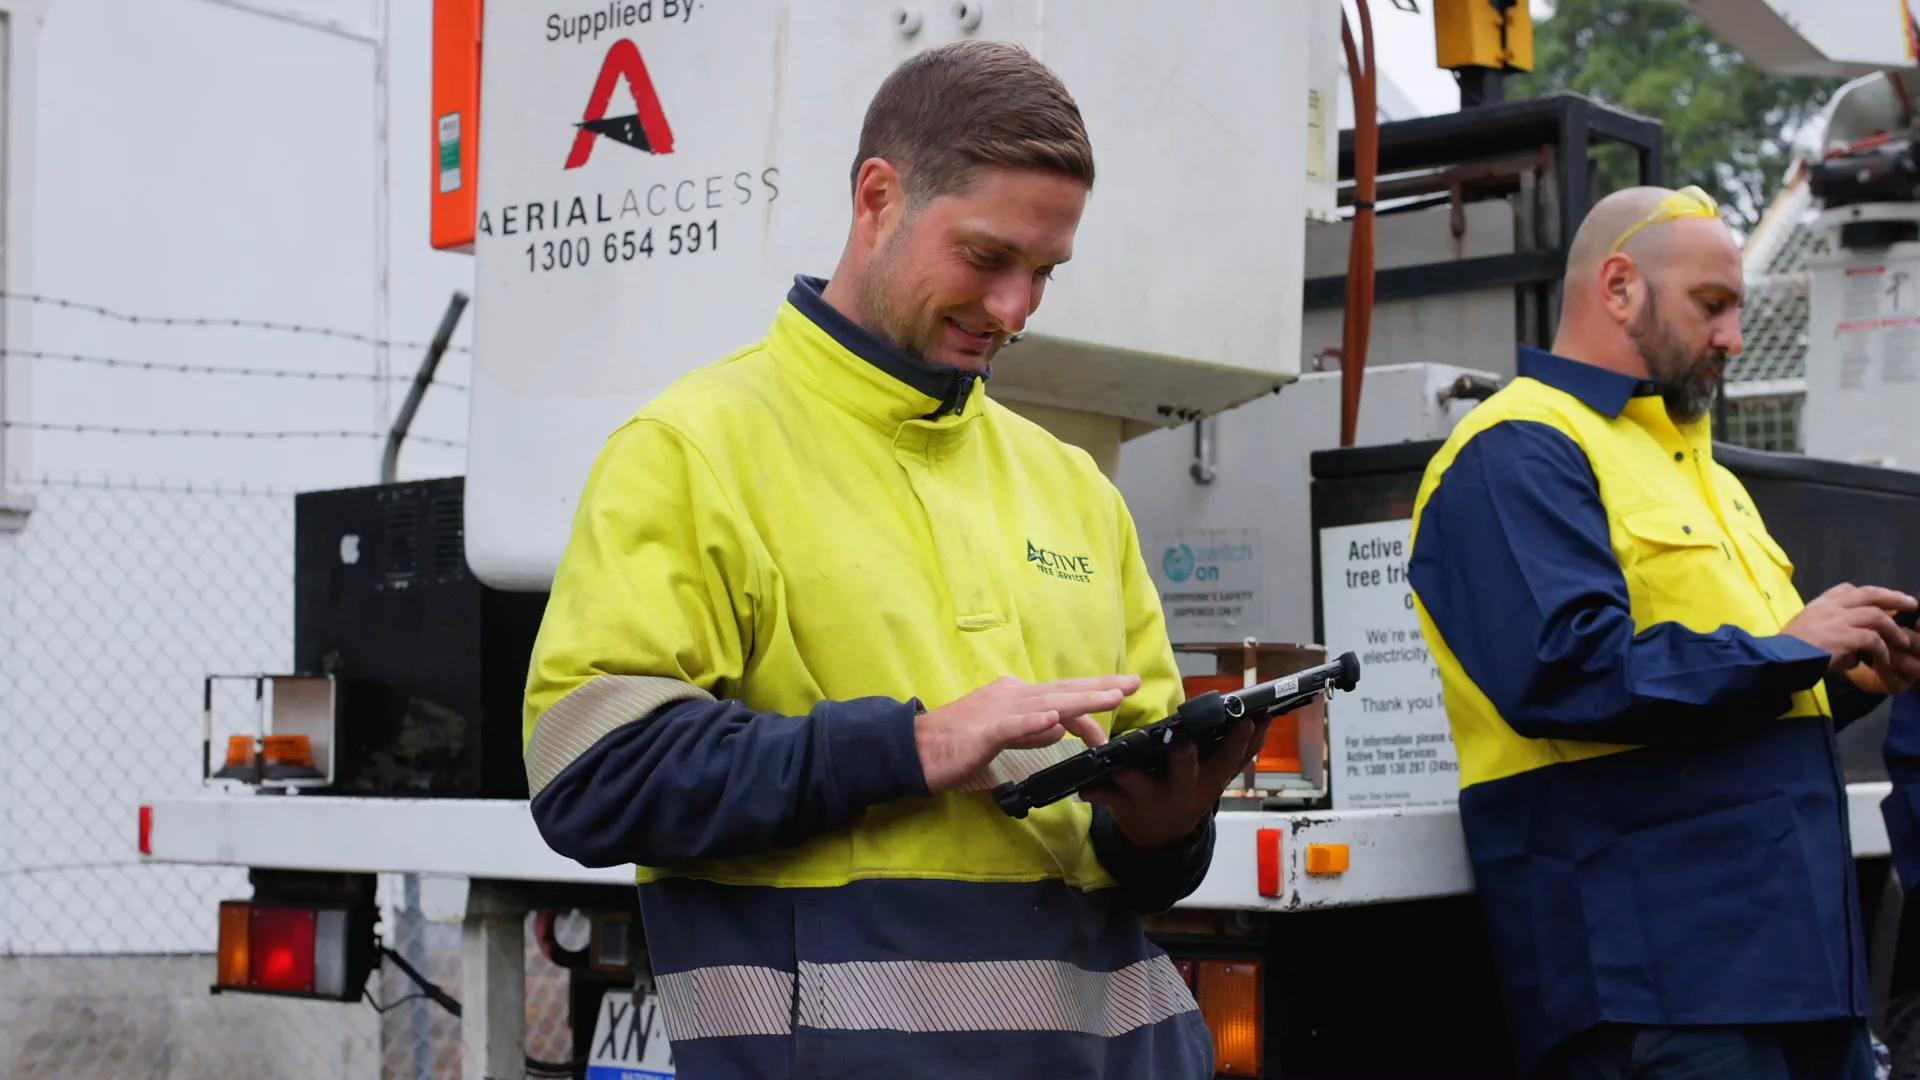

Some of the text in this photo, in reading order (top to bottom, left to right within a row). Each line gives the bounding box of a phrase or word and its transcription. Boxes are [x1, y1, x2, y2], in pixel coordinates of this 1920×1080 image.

[546, 0, 653, 43] Supplied
[525, 219, 720, 273] 1300 654 591
[1026, 540, 1094, 575] ACTIVE
[1348, 538, 1402, 561] Active
[1037, 564, 1054, 576] TREE
[1195, 565, 1220, 581] on
[1346, 562, 1409, 588] tree tri
[1366, 628, 1406, 645] We're
[1363, 647, 1428, 666] electricity
[1361, 696, 1402, 713] Thank
[1407, 697, 1434, 714] you
[1347, 747, 1437, 762] Active Tree Services
